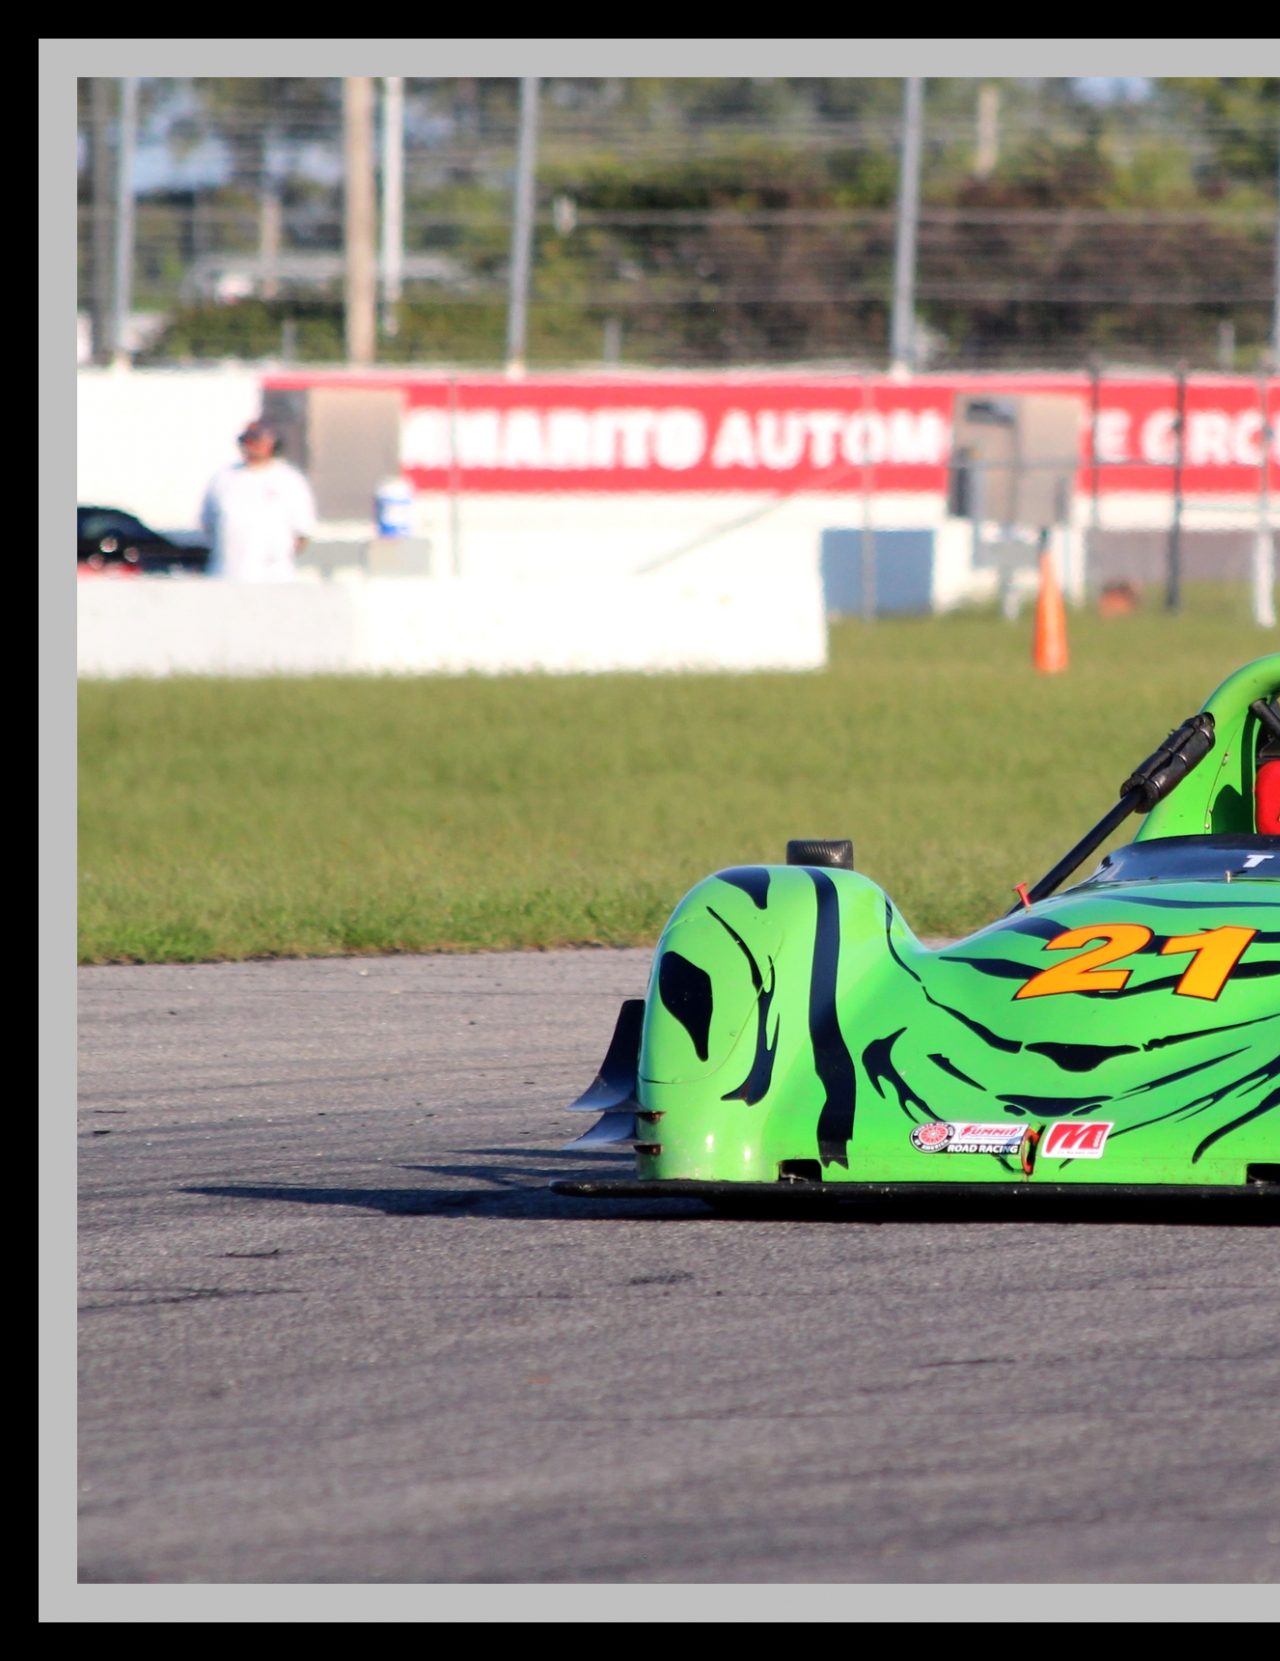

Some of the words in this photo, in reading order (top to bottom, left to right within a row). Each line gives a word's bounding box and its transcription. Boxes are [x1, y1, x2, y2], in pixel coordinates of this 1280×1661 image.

[1010, 922, 1261, 1002] 21
[961, 1125, 1020, 1138] SUMMIT
[947, 1143, 977, 1154] ROAD
[978, 1143, 1019, 1154] RACING
